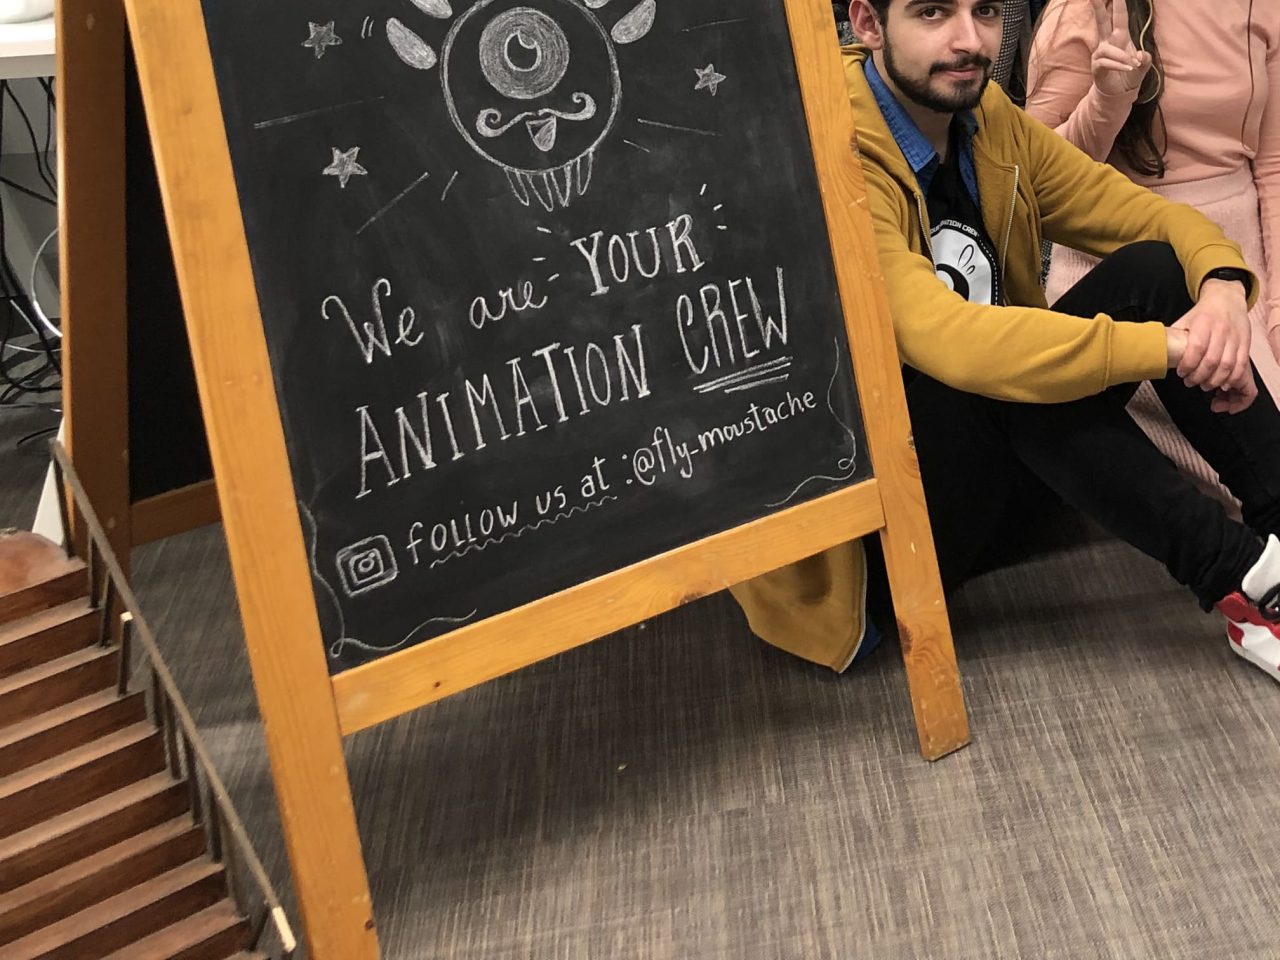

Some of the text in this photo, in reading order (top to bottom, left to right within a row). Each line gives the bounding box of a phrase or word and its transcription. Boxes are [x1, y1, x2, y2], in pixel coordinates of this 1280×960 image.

[322, 213, 705, 363] We are YOUR
[354, 266, 788, 499] ANIMATION CREW
[580, 456, 610, 498] at
